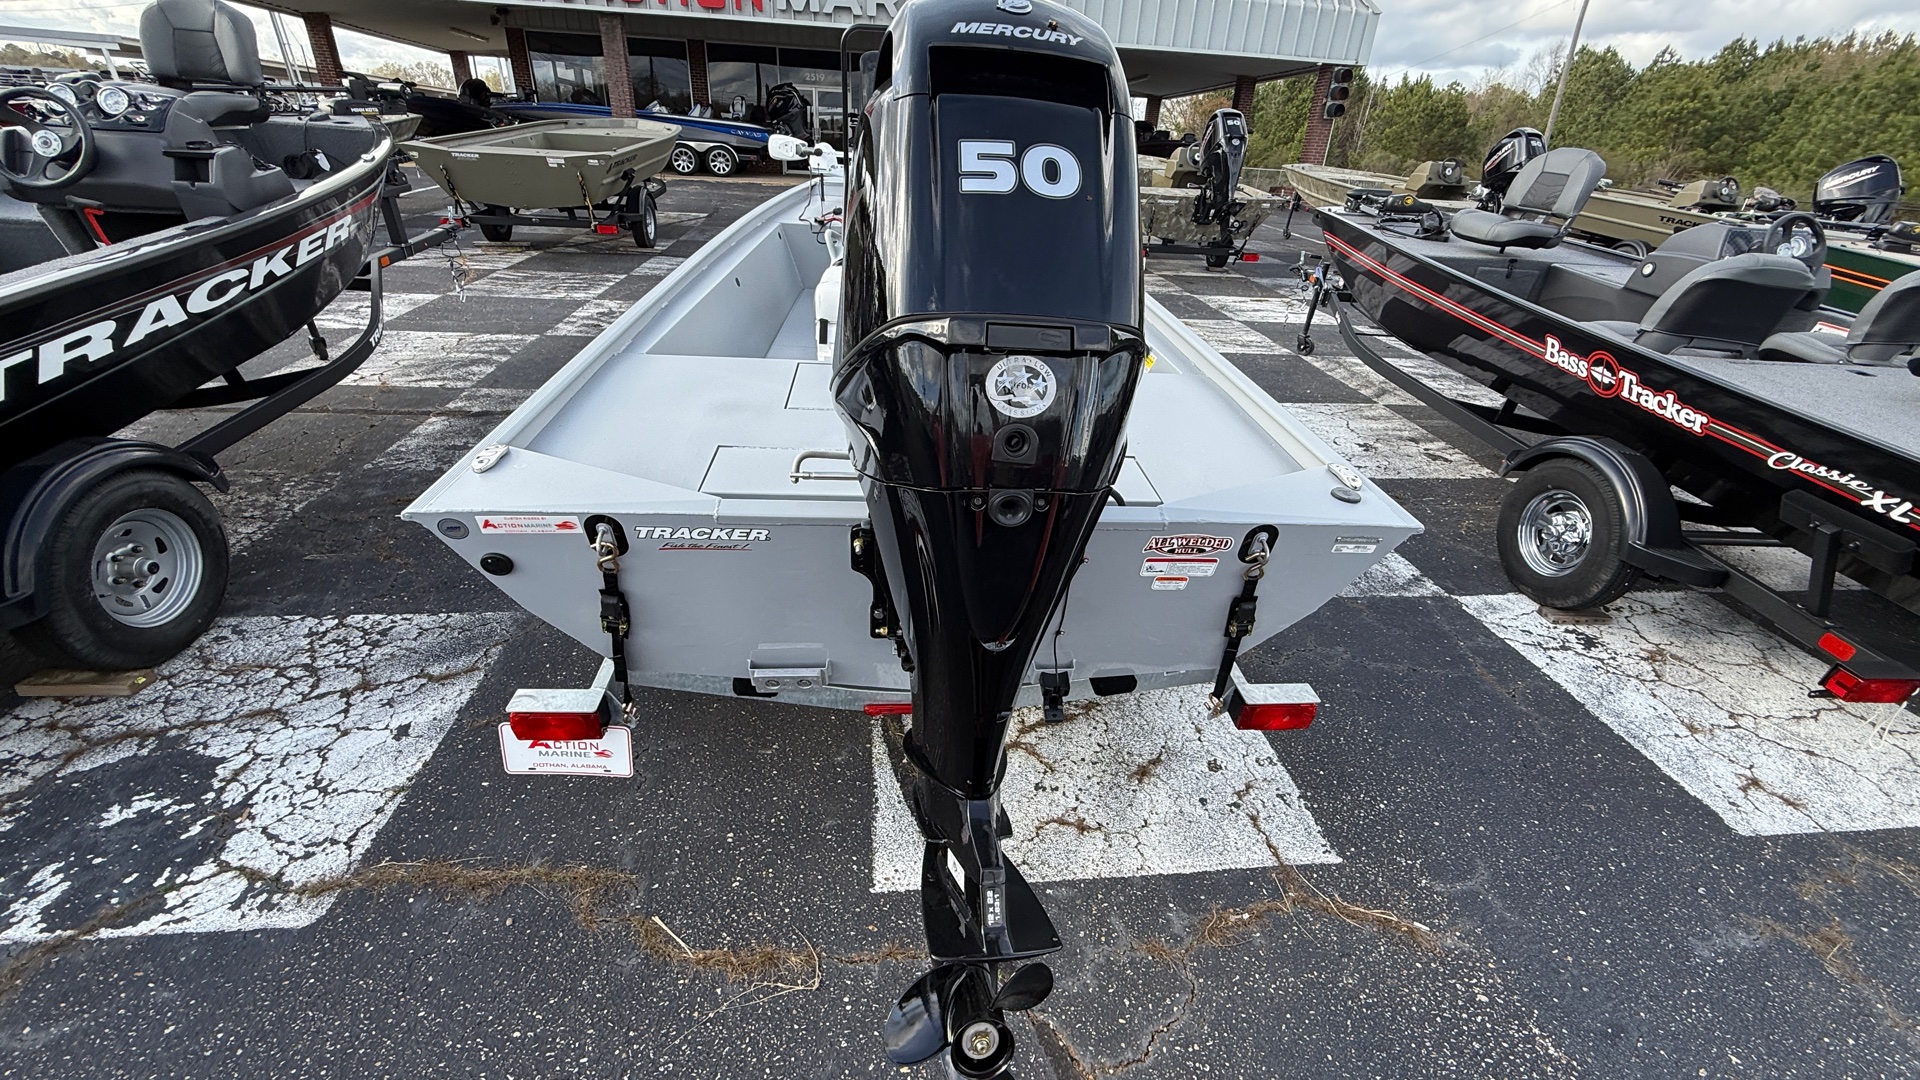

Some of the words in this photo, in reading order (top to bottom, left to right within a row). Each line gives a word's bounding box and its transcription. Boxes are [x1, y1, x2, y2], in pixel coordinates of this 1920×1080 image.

[951, 22, 1083, 45] MERCURY
[805, 72, 825, 81] 2519
[958, 139, 1082, 199] 50
[1658, 215, 1702, 228] TRACK
[1034, 361, 1052, 377] LOW
[1545, 335, 1589, 379] Bass
[1618, 370, 1709, 434] Tracker
[1767, 451, 1874, 494] Classic
[1860, 489, 1912, 524] XL
[634, 525, 770, 541] TRACKER
[1146, 537, 1174, 550] ALL
[1176, 537, 1232, 550] WELDED
[538, 750, 591, 758] MARINE
